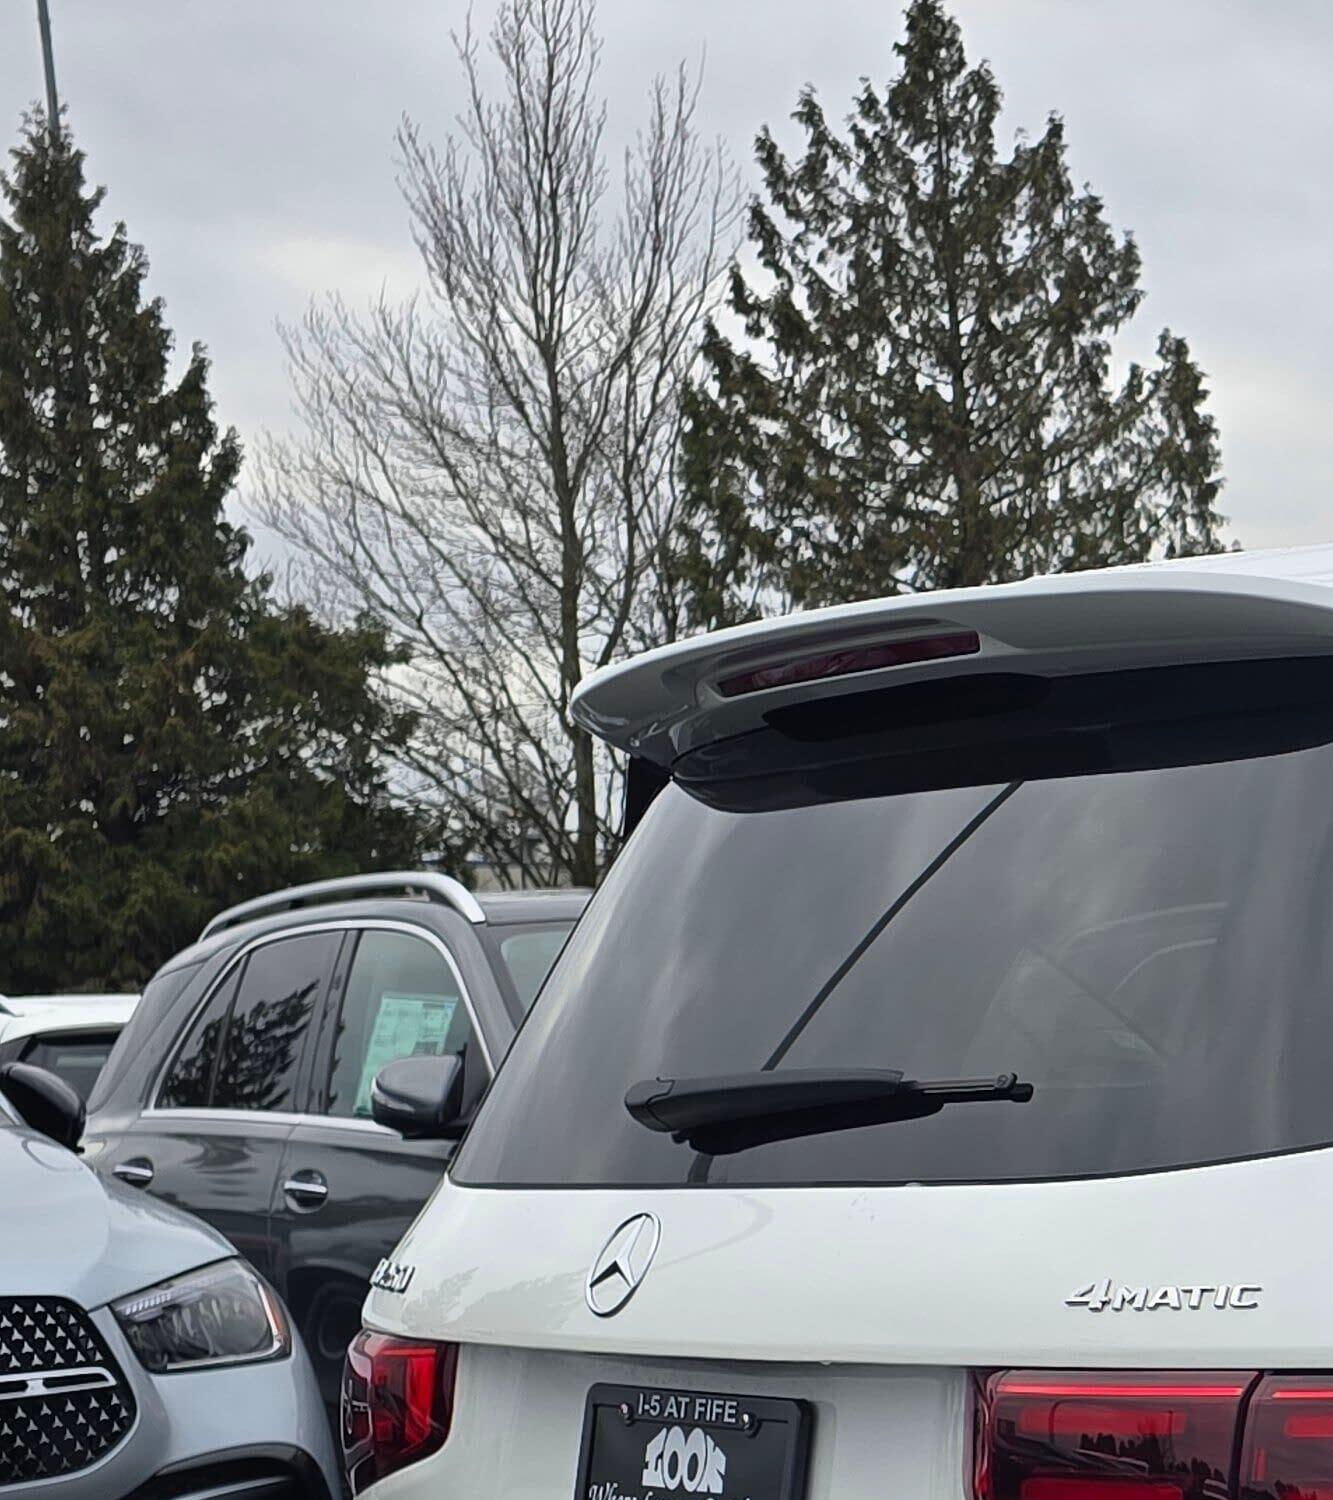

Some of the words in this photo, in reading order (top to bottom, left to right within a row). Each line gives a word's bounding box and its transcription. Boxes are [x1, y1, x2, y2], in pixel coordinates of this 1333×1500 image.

[1065, 1278, 1263, 1312] 4MATIC
[638, 1393, 661, 1417] I-5
[664, 1396, 690, 1420] AT
[694, 1399, 737, 1423] FIFE
